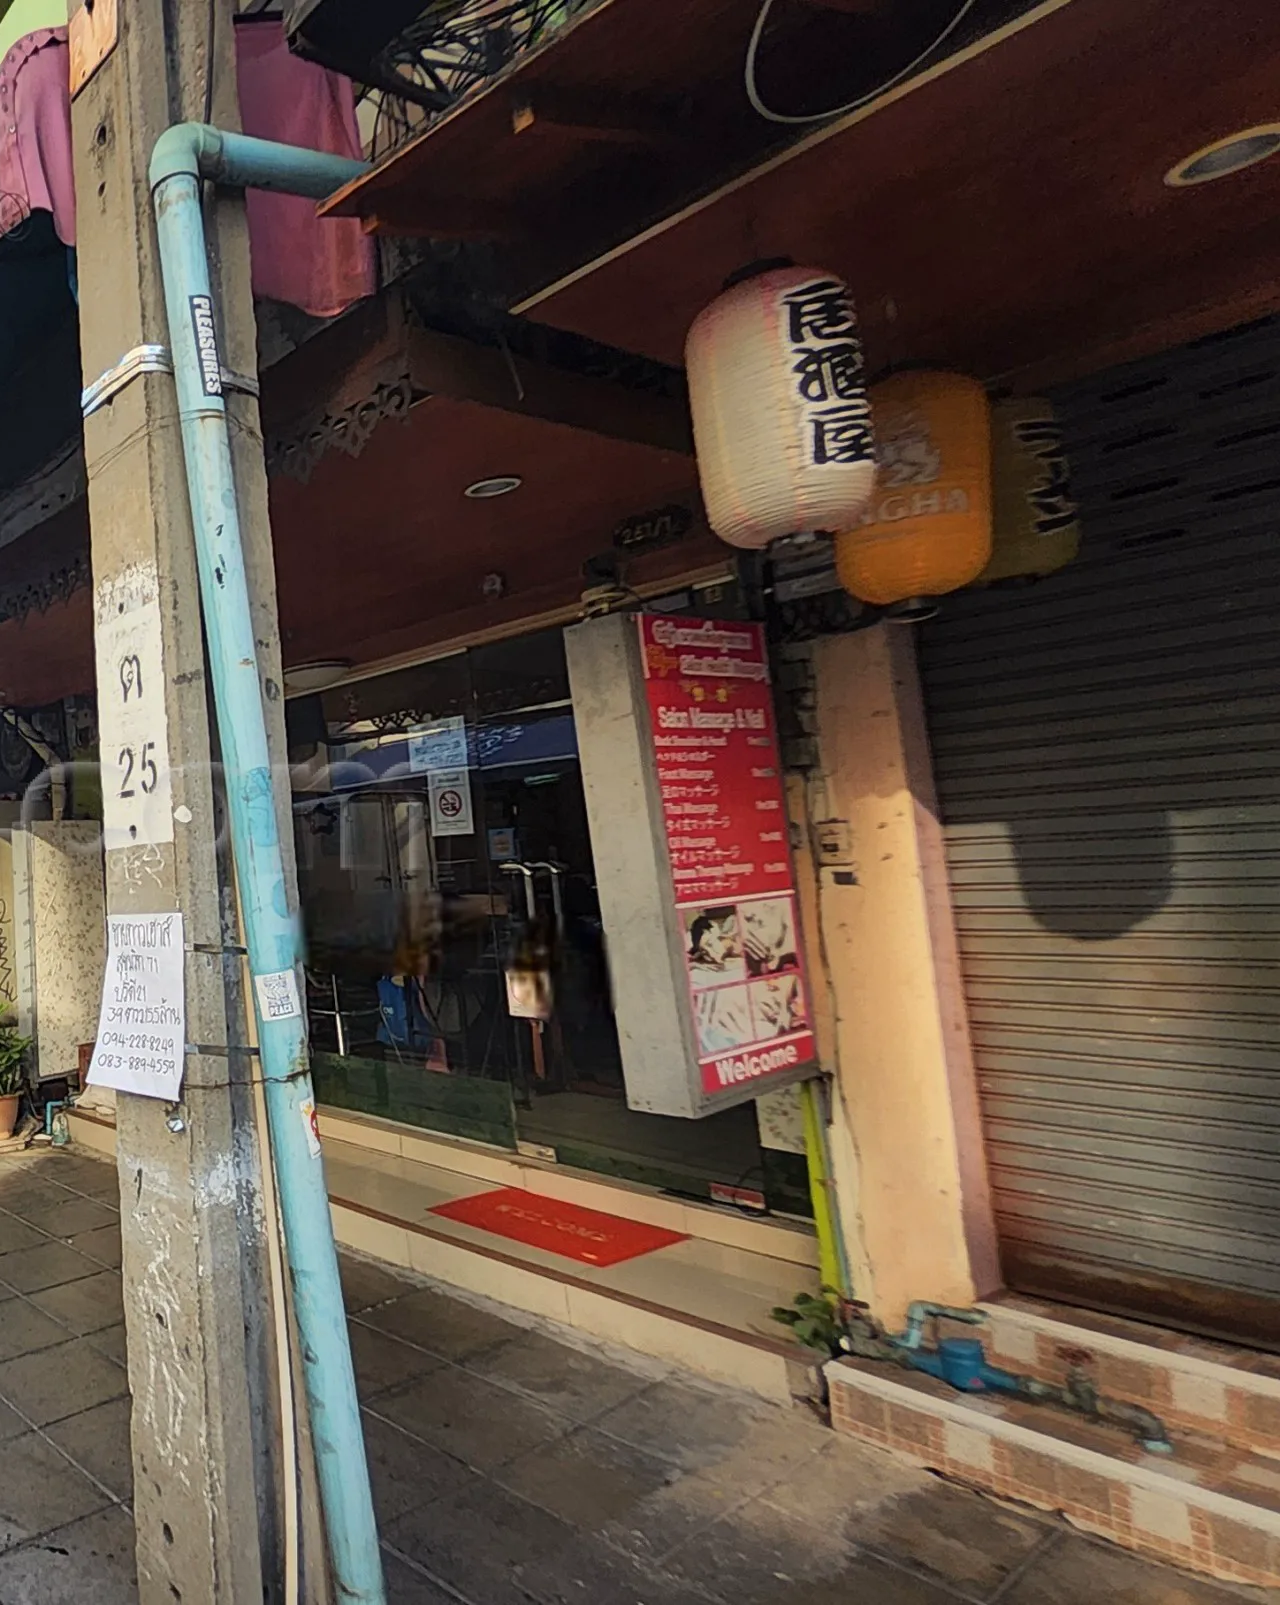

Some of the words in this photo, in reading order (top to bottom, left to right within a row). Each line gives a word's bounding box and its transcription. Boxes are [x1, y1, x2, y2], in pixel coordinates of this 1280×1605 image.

[192, 297, 222, 394] PLEASURES
[117, 742, 157, 798] 25
[715, 1045, 798, 1085] Welcome
